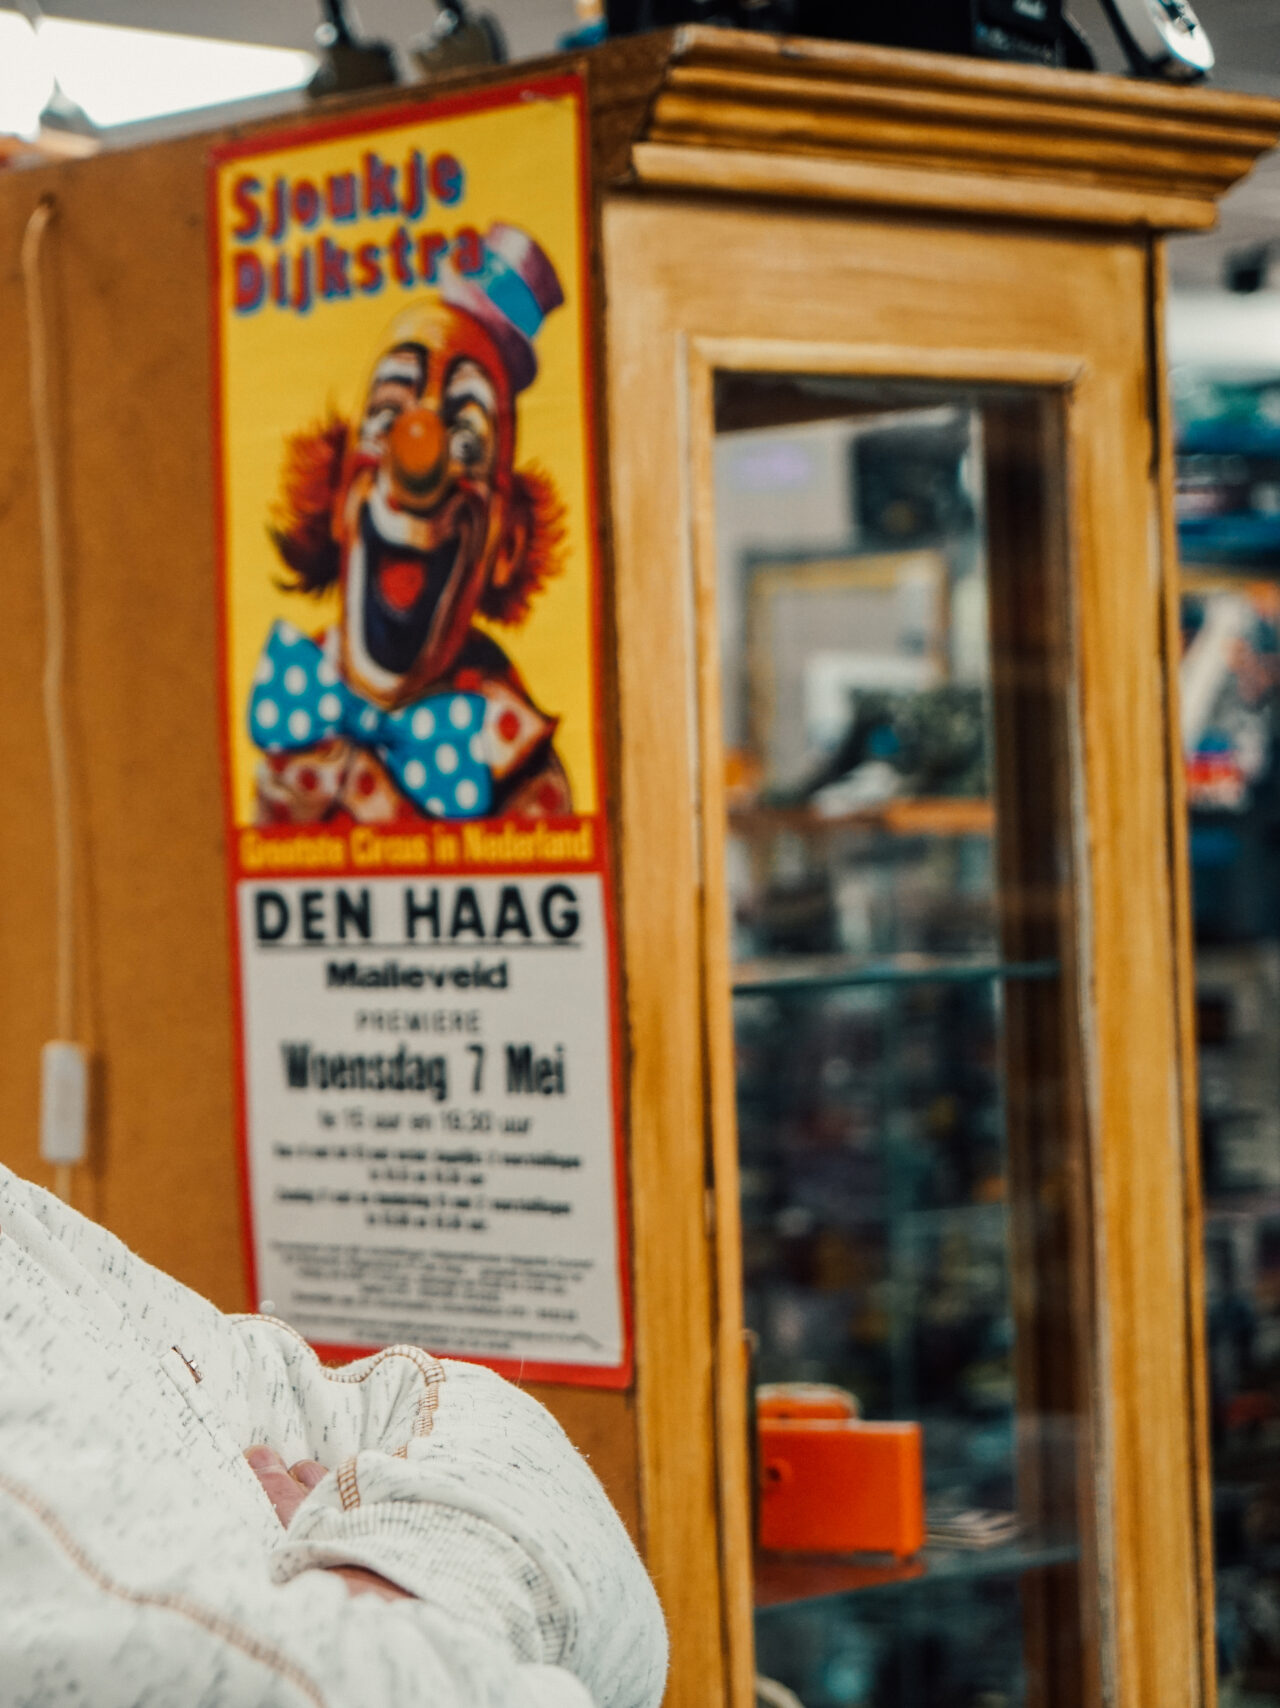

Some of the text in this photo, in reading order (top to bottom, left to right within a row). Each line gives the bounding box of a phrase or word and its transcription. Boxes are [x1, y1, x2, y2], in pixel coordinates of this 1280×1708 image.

[232, 147, 465, 245] Sjoukje
[232, 224, 485, 316] Dijkstra
[433, 824, 459, 864] in
[463, 820, 593, 864] Nederland
[255, 882, 580, 942] DEN HAAG
[326, 959, 508, 989] Malieveld
[356, 1009, 481, 1033] PREMIERE
[282, 1043, 566, 1102] Woensdag 7 Mei
